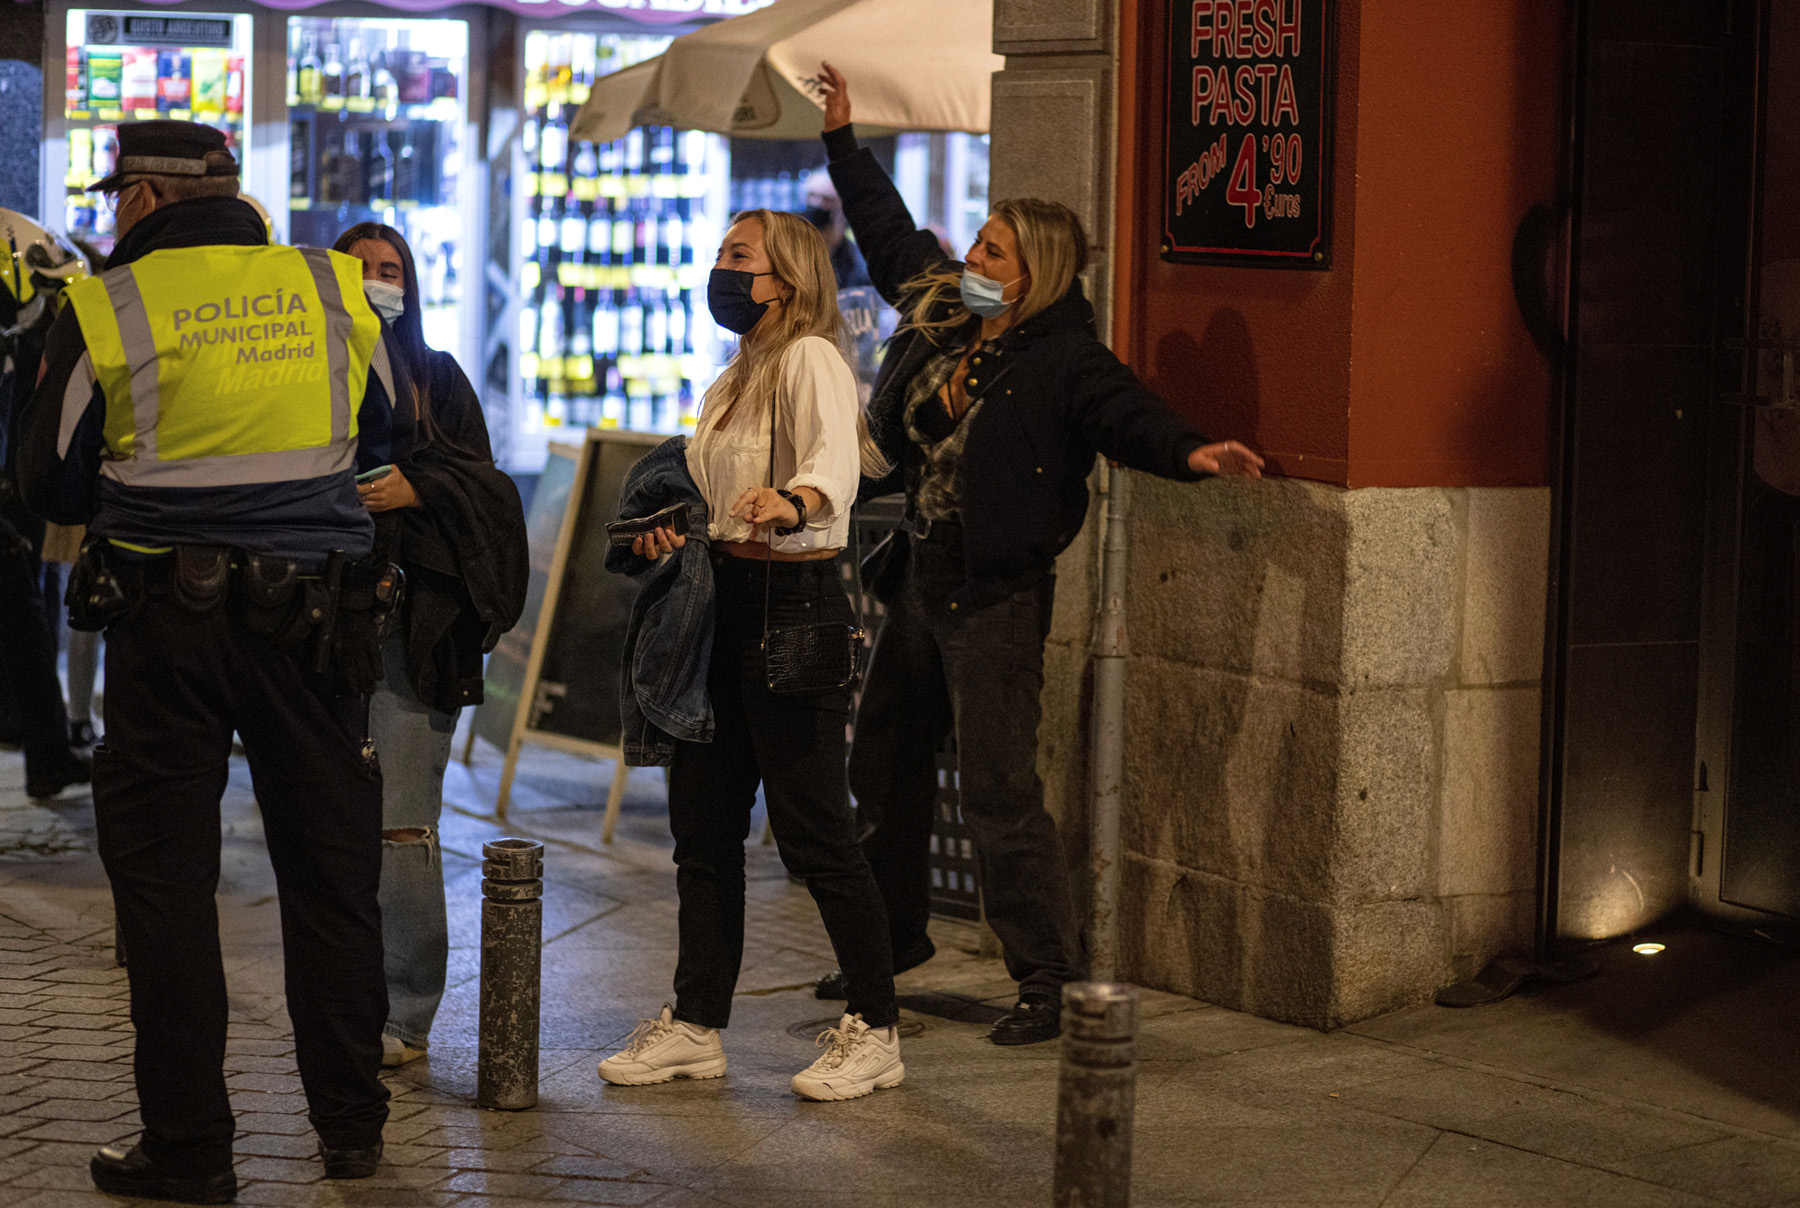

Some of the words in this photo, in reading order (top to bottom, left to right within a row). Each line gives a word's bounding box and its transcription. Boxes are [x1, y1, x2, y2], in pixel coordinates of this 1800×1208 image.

[1191, 0, 1301, 59] FRESH
[1192, 64, 1299, 127] PASTA
[1176, 133, 1227, 216] FROM
[173, 288, 307, 331] POLICÍA
[179, 320, 313, 350] MUNICIPAL
[236, 340, 315, 365] Madrid
